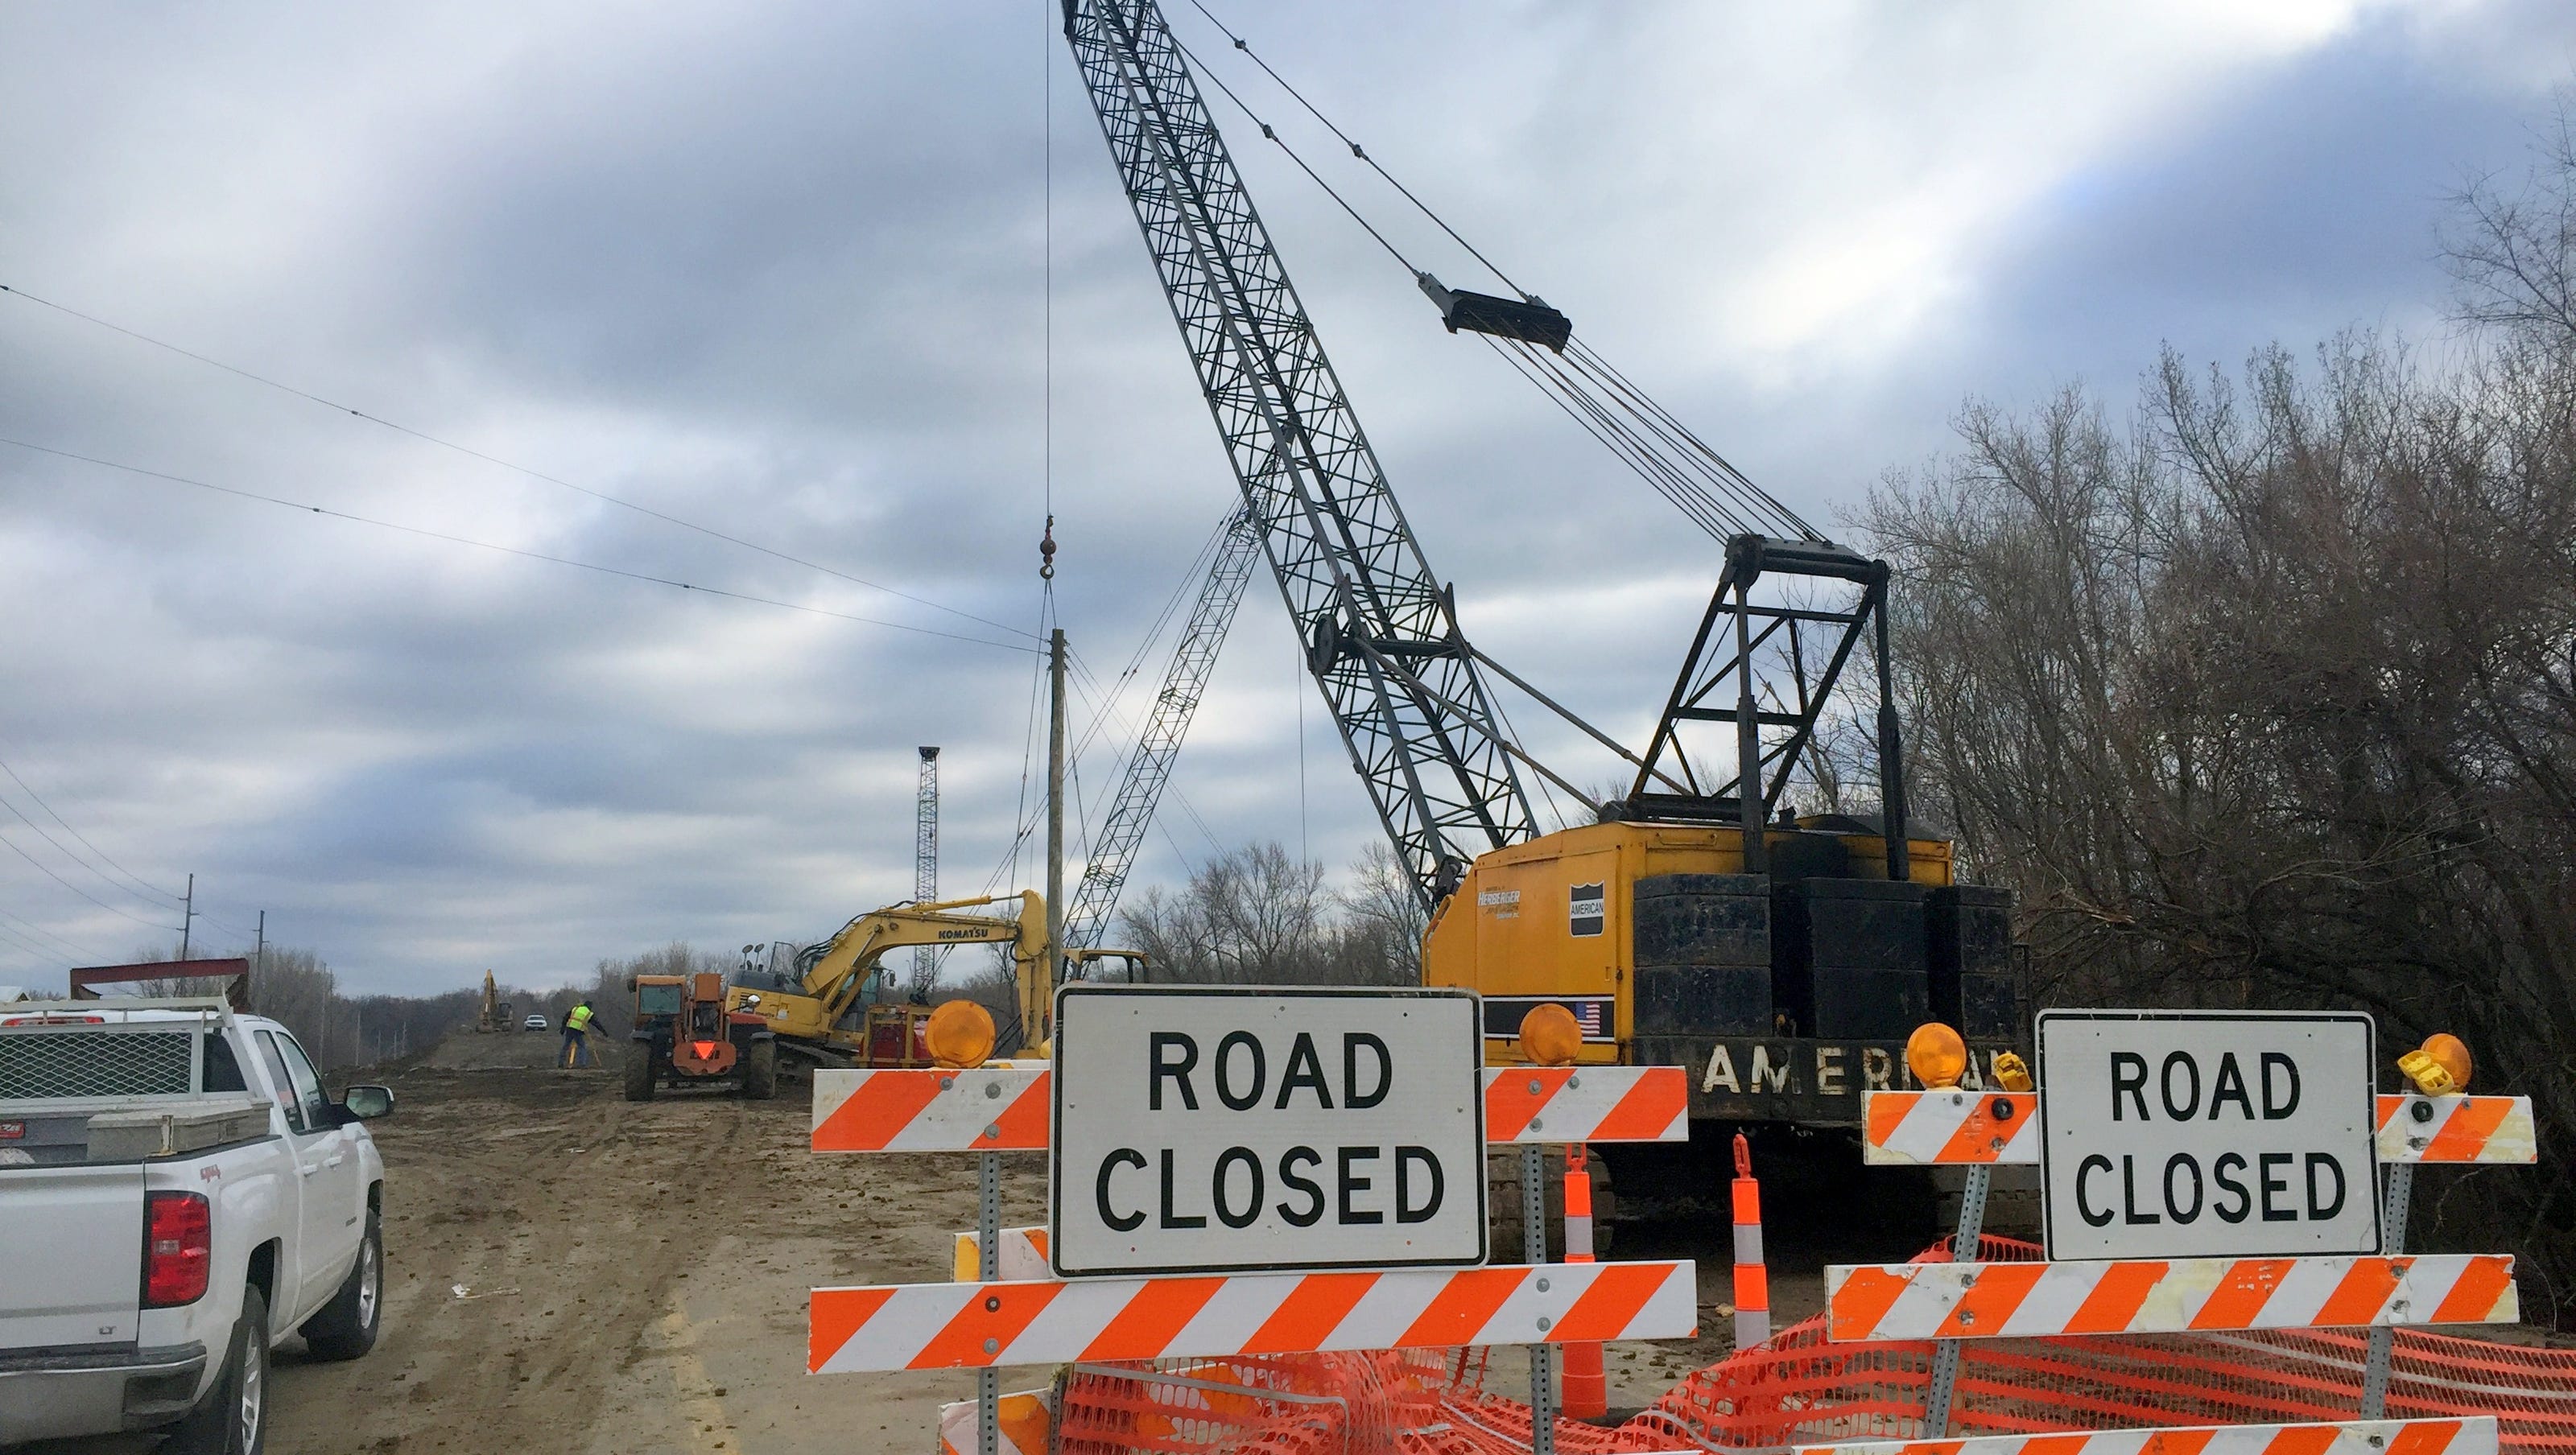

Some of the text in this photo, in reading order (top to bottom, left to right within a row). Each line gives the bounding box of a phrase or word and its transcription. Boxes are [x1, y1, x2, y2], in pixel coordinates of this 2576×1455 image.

[939, 927, 989, 939] KOMATSU
[1571, 901, 1604, 915] AMERICAN
[1150, 1030, 1393, 1111] ROAD
[1700, 1044, 2013, 1095] AMERIA
[2110, 1050, 2301, 1122] ROAD
[1096, 1146, 1445, 1232] CLOSED
[2075, 1152, 2347, 1227] CLOSED
